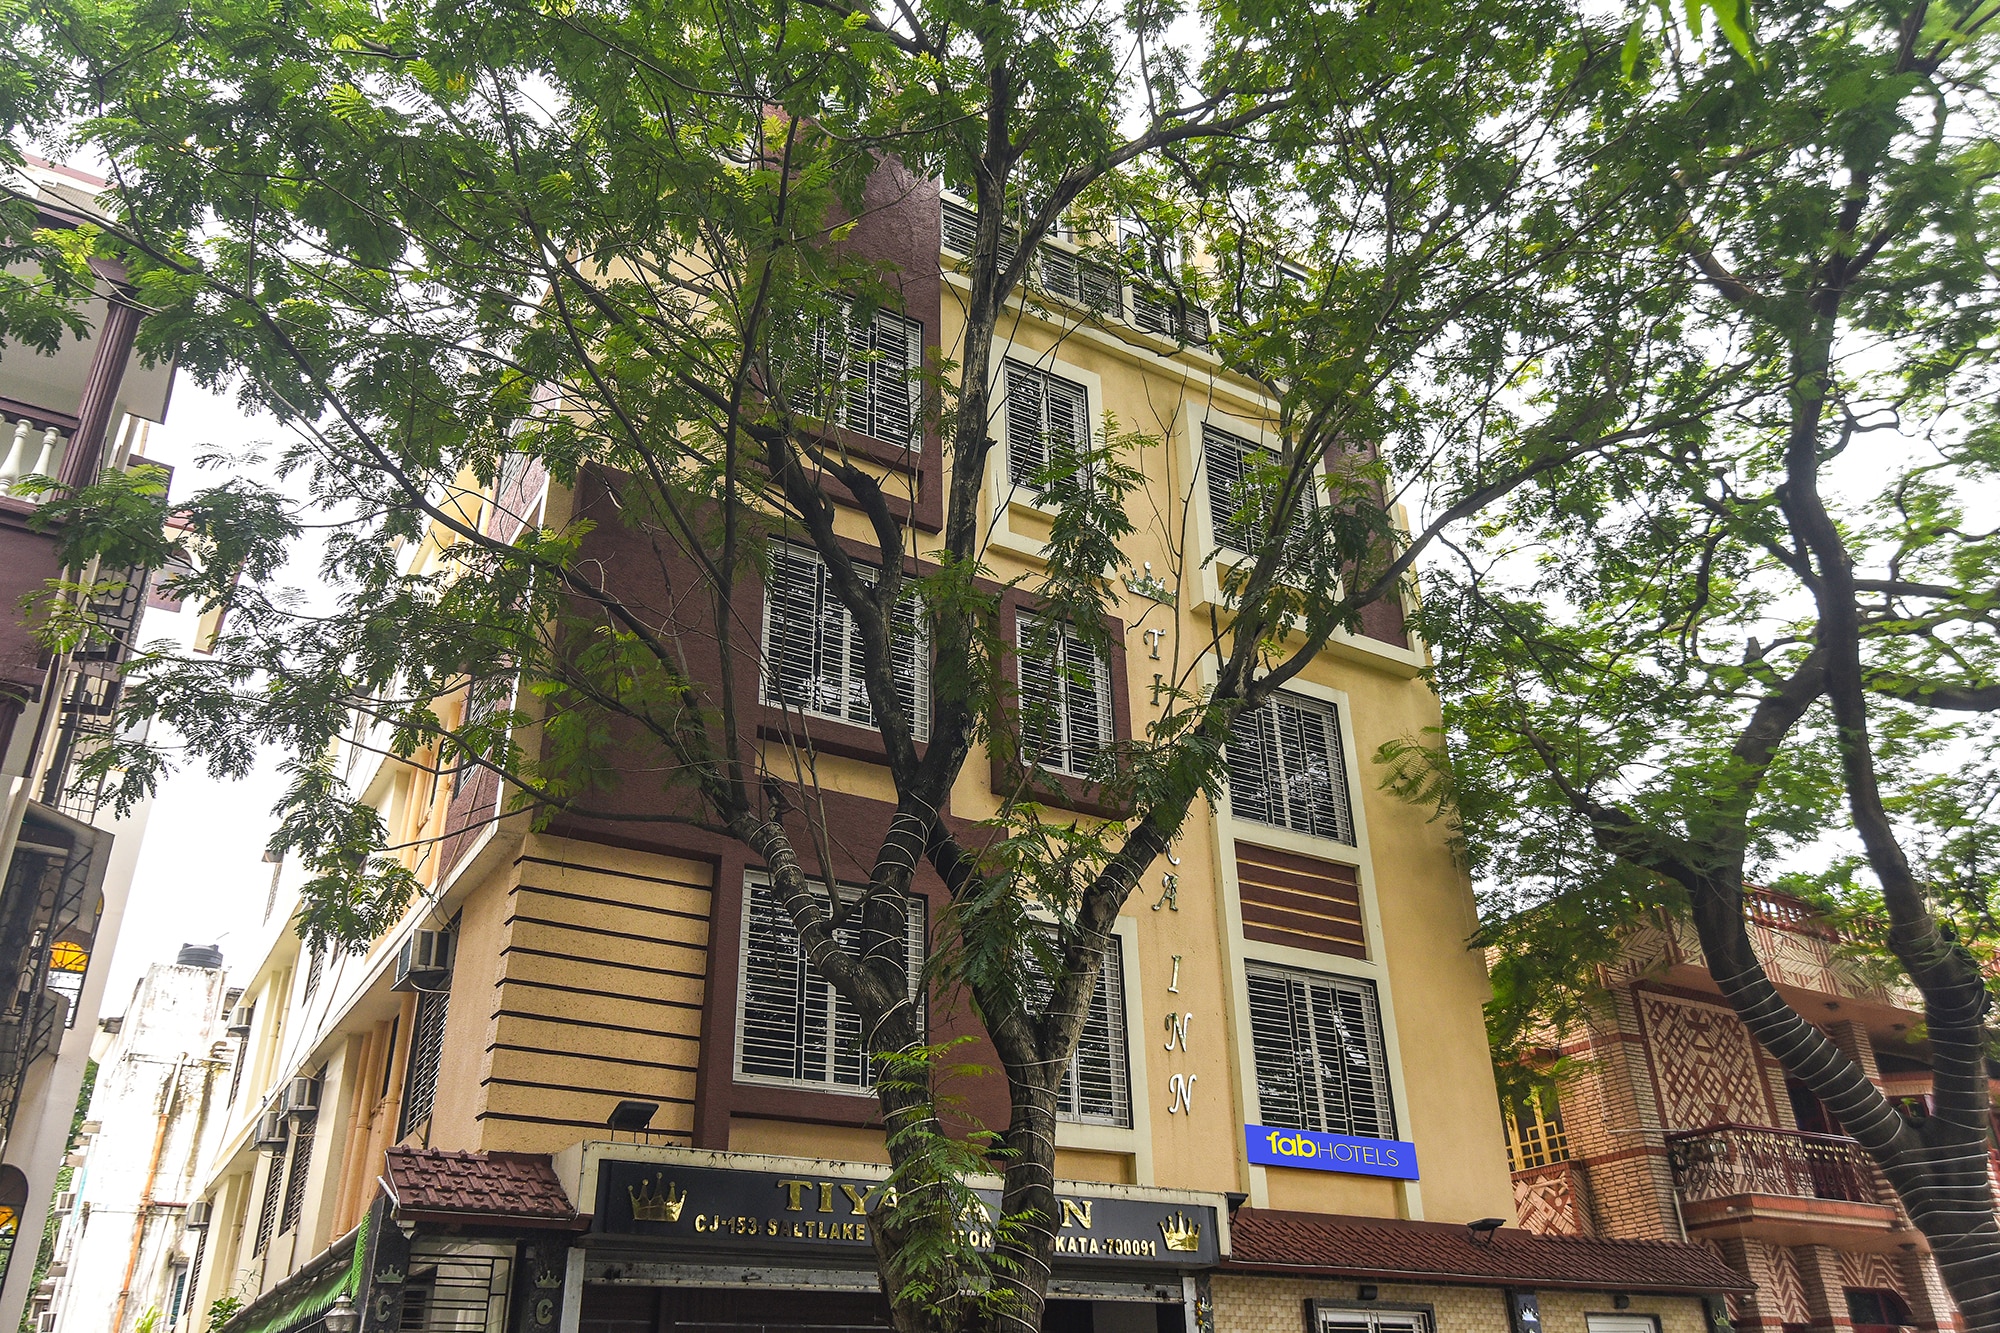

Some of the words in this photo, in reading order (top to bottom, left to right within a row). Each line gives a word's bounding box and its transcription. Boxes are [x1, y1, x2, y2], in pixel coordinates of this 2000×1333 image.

[1164, 955, 1197, 1116] INN
[1265, 1131, 1399, 1167] fabHOTELS
[767, 1218, 866, 1242] SALTLAKE
[1055, 1235, 1157, 1257] KATA-700091
